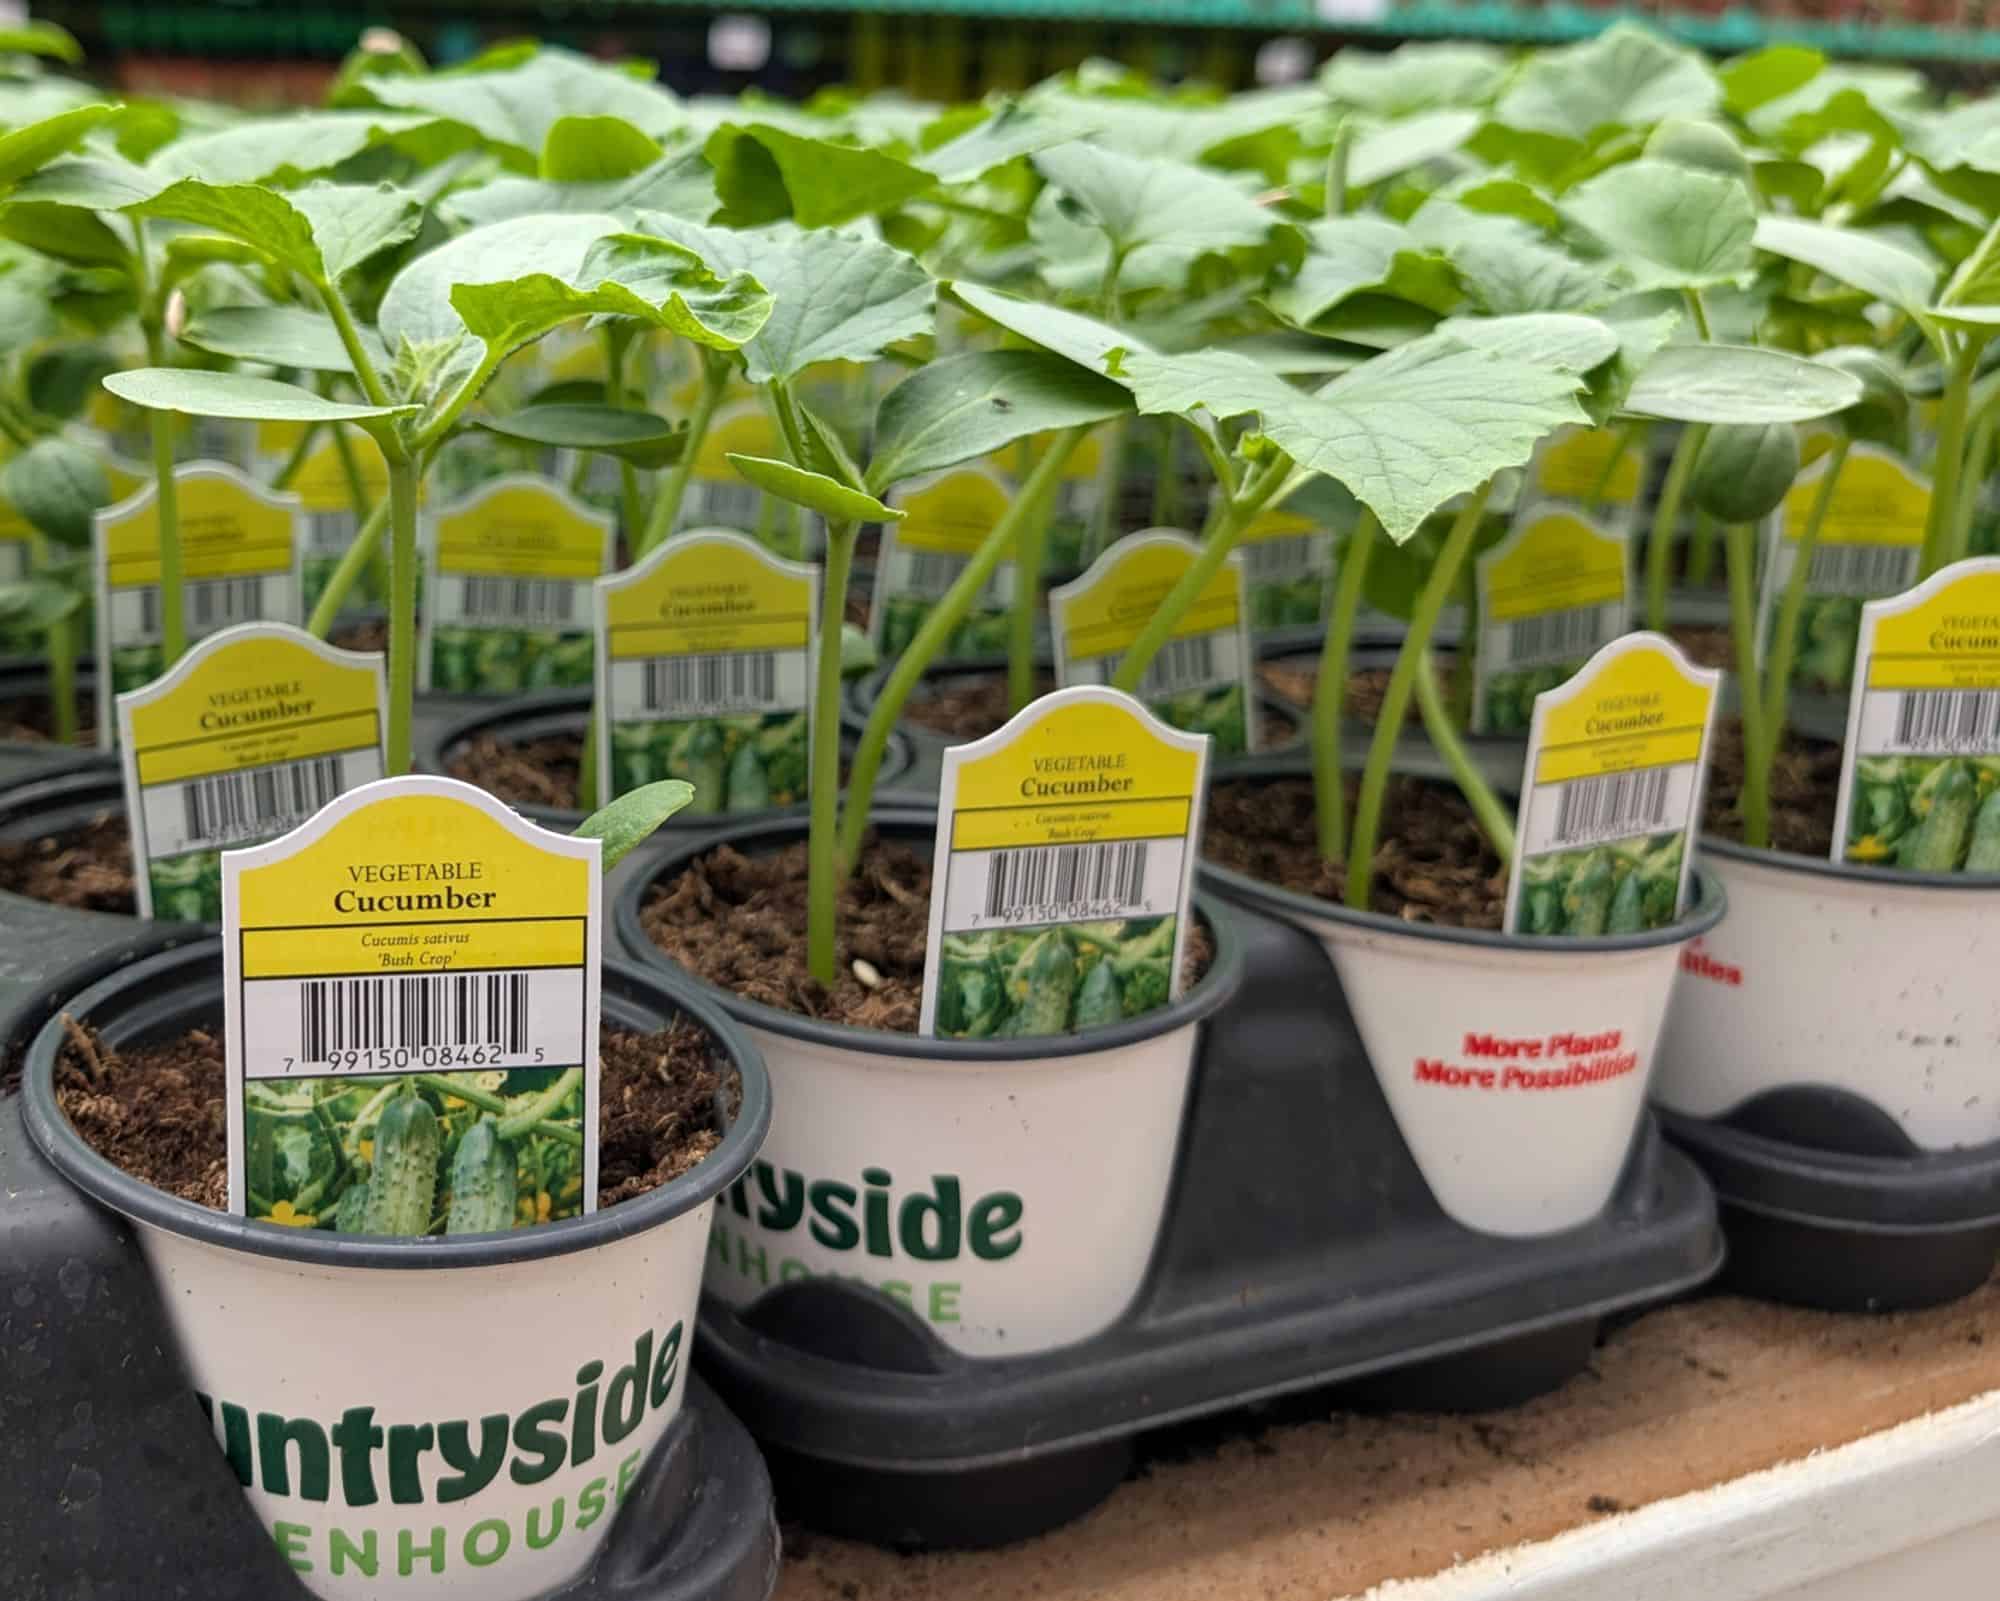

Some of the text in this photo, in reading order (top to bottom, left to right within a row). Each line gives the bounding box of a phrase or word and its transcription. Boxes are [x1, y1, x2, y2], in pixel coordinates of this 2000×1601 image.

[200, 699, 316, 731] Cucumber
[1033, 754, 1127, 773] VEGETABLE
[1020, 774, 1134, 798] Cucumber
[348, 862, 484, 884] VEGETABLE
[334, 886, 497, 914] Cucumber
[361, 931, 470, 948] Cucumis sativus
[1462, 1031, 1542, 1058] More
[284, 1044, 545, 1073] 7 99150 08462 5
[1413, 1058, 1496, 1088] More
